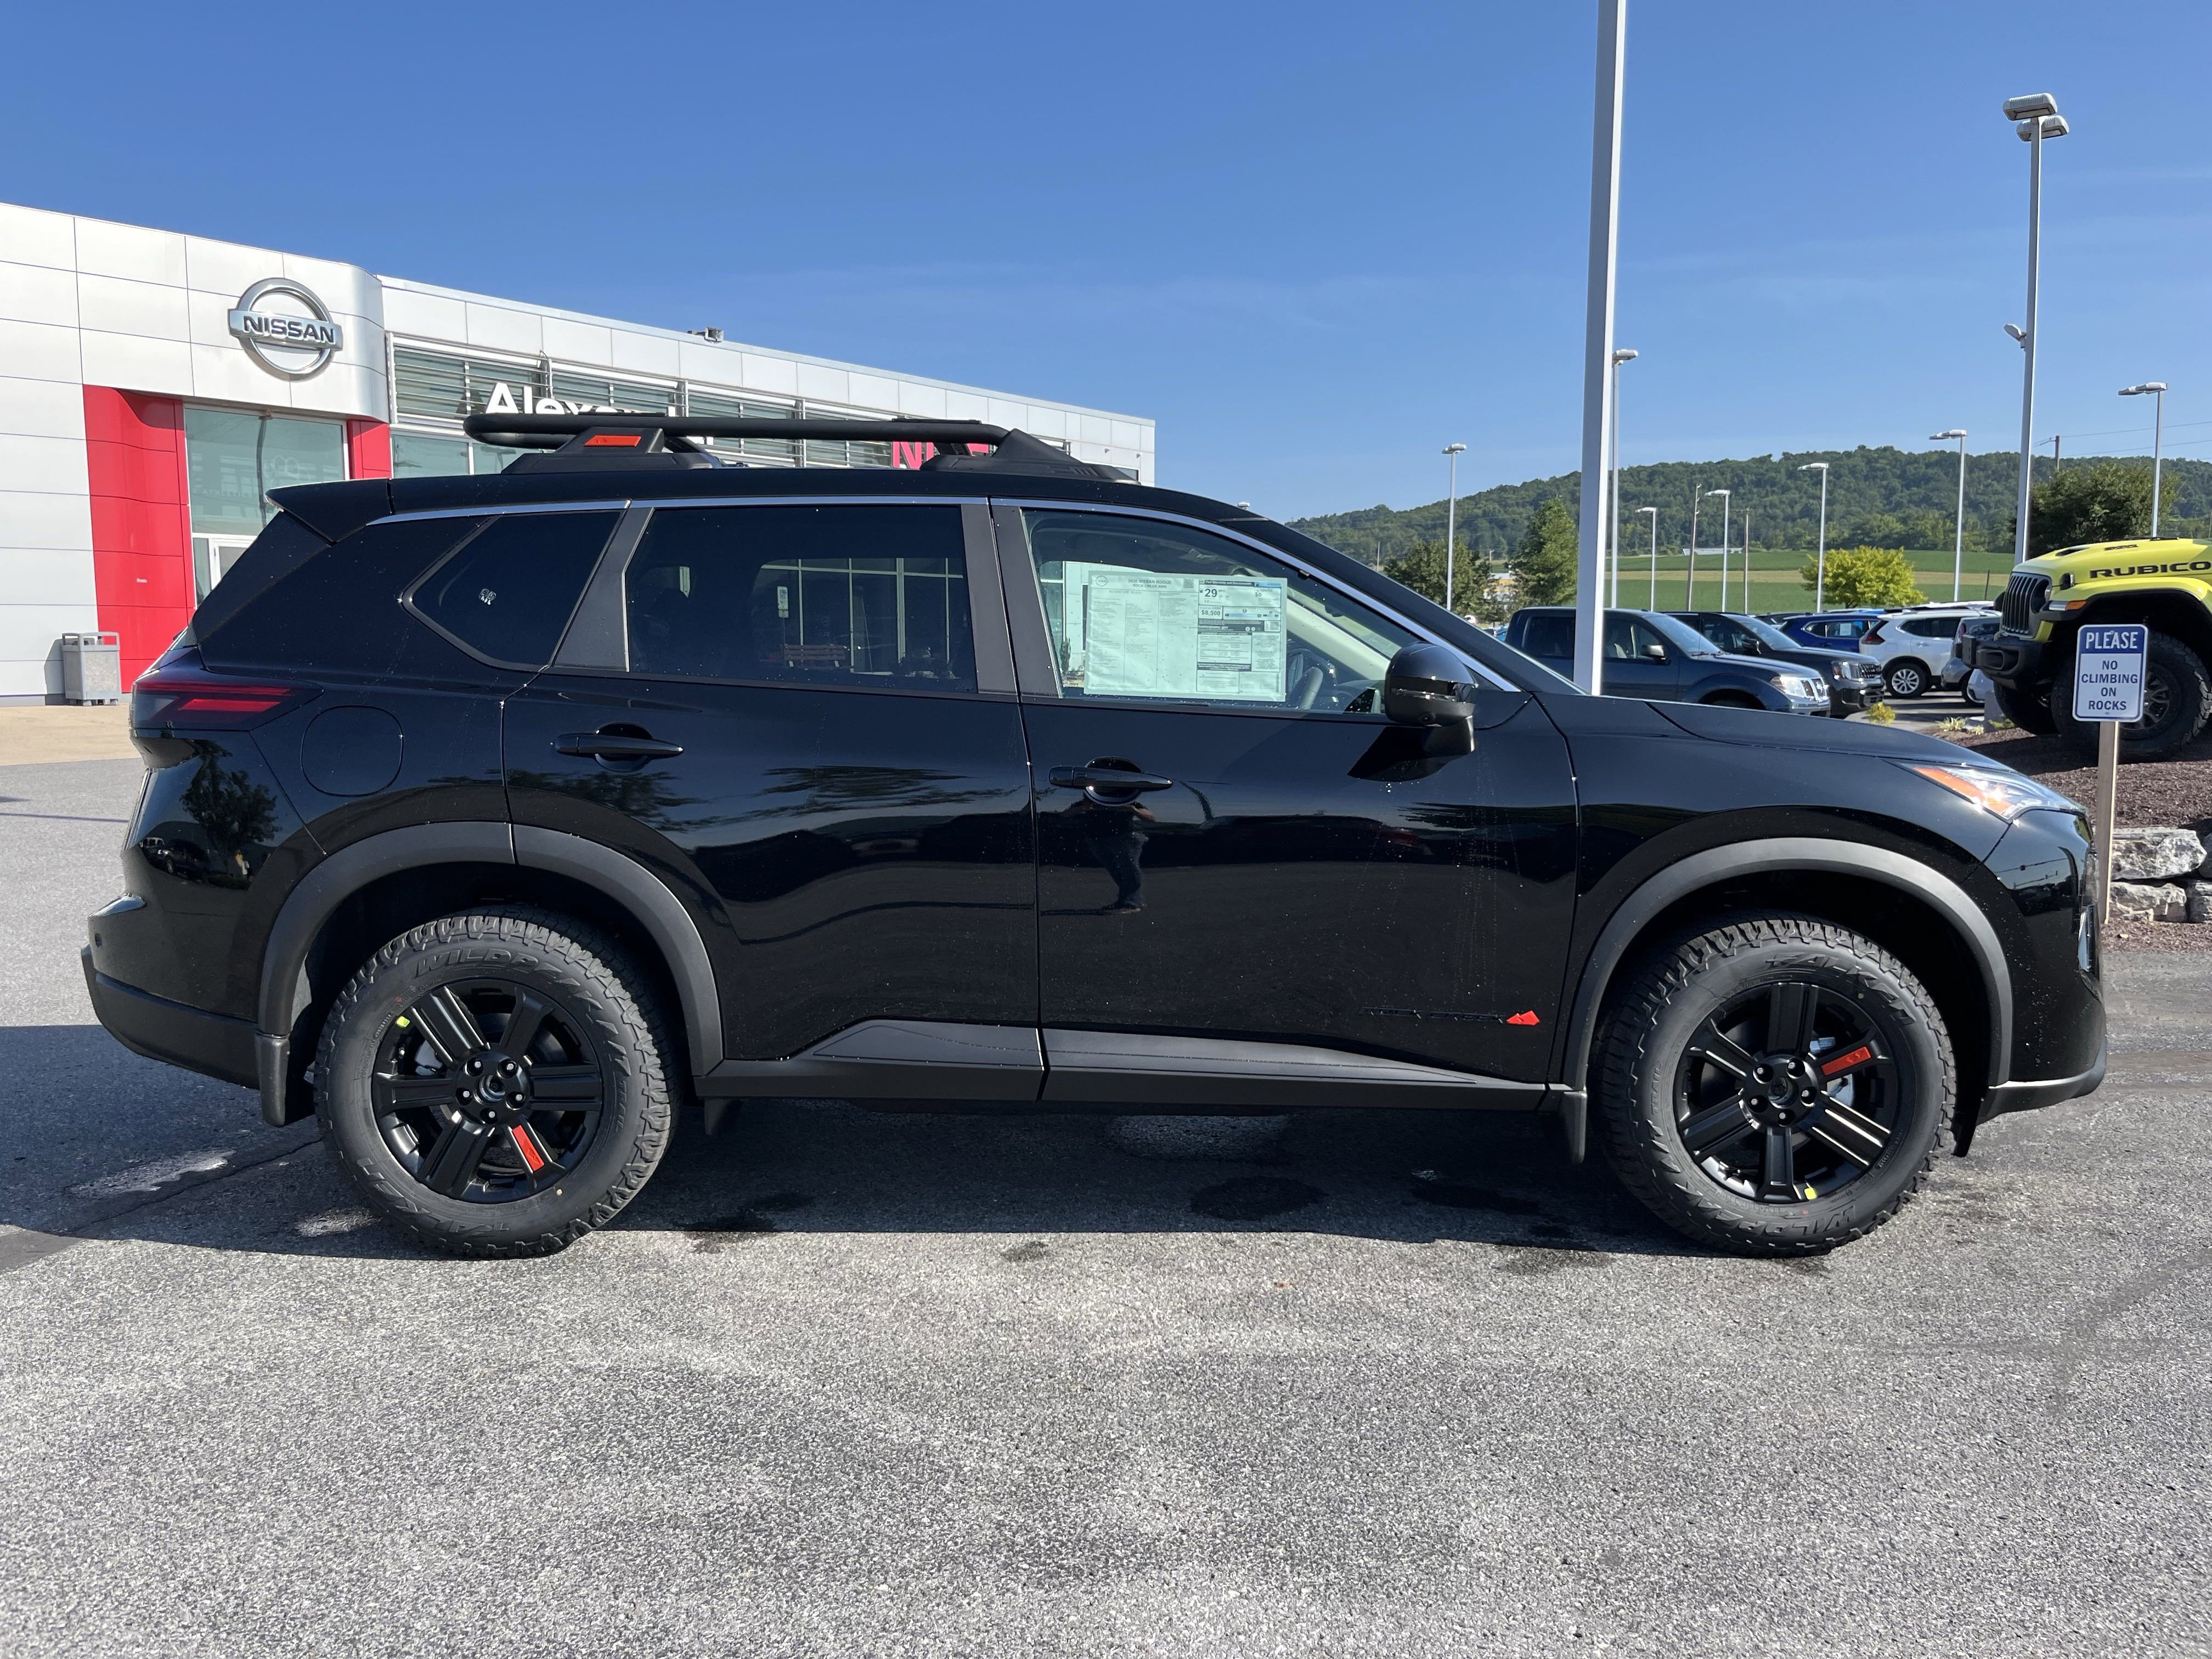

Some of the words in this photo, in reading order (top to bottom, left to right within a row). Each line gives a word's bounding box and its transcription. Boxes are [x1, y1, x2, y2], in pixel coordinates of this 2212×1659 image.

[243, 315, 336, 343] NISSAN
[1205, 588, 1217, 597] 29
[2086, 631, 2138, 649] PLEASE
[2102, 661, 2118, 670] NO
[2081, 674, 2138, 684] CLIMBING
[2101, 687, 2117, 697] ON
[2088, 701, 2127, 710] ROCKS
